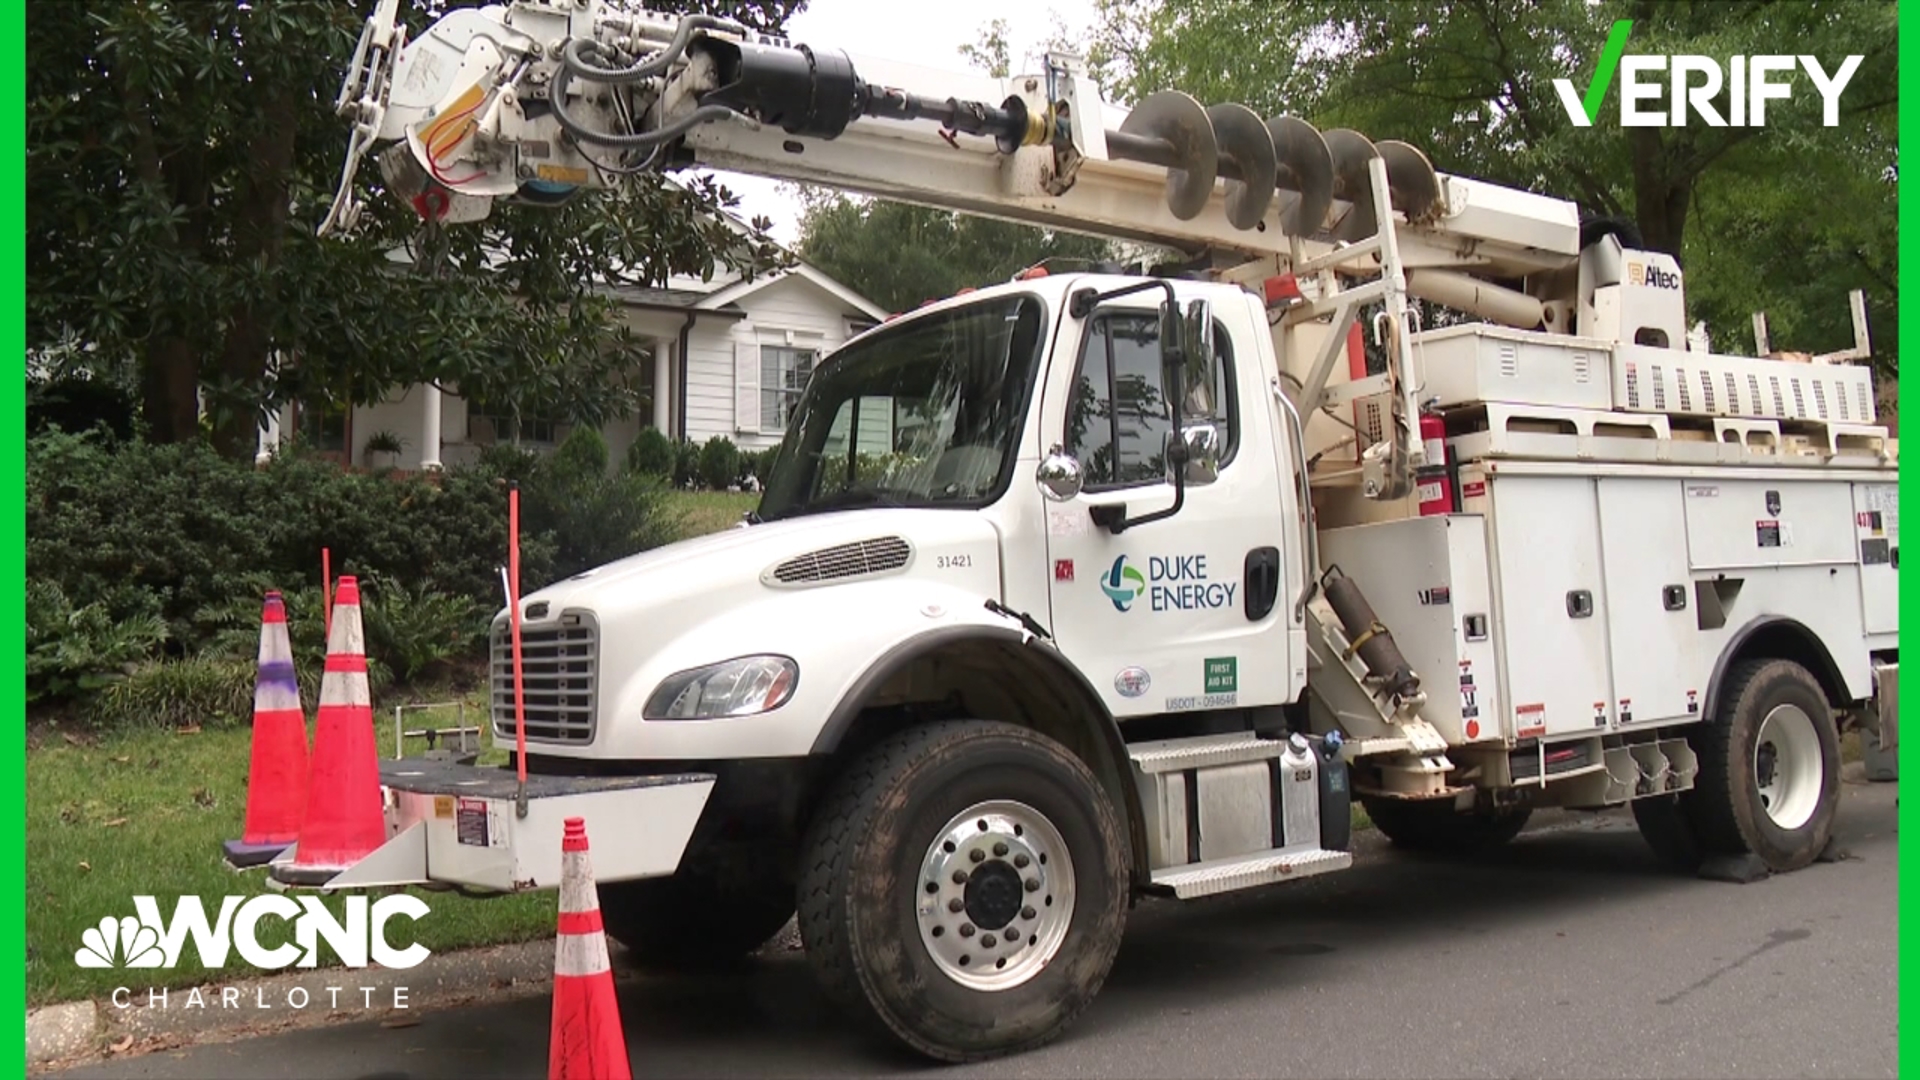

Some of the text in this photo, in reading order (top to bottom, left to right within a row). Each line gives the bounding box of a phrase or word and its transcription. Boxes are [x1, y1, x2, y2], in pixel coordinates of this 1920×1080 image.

[1645, 265, 1679, 289] Altec
[937, 555, 972, 568] 31421
[1149, 555, 1207, 581] DUKE
[1151, 582, 1236, 611] ENERGY
[1210, 663, 1231, 674] FIRST
[1207, 676, 1233, 687] AID KIT
[1166, 697, 1195, 710] USDOT
